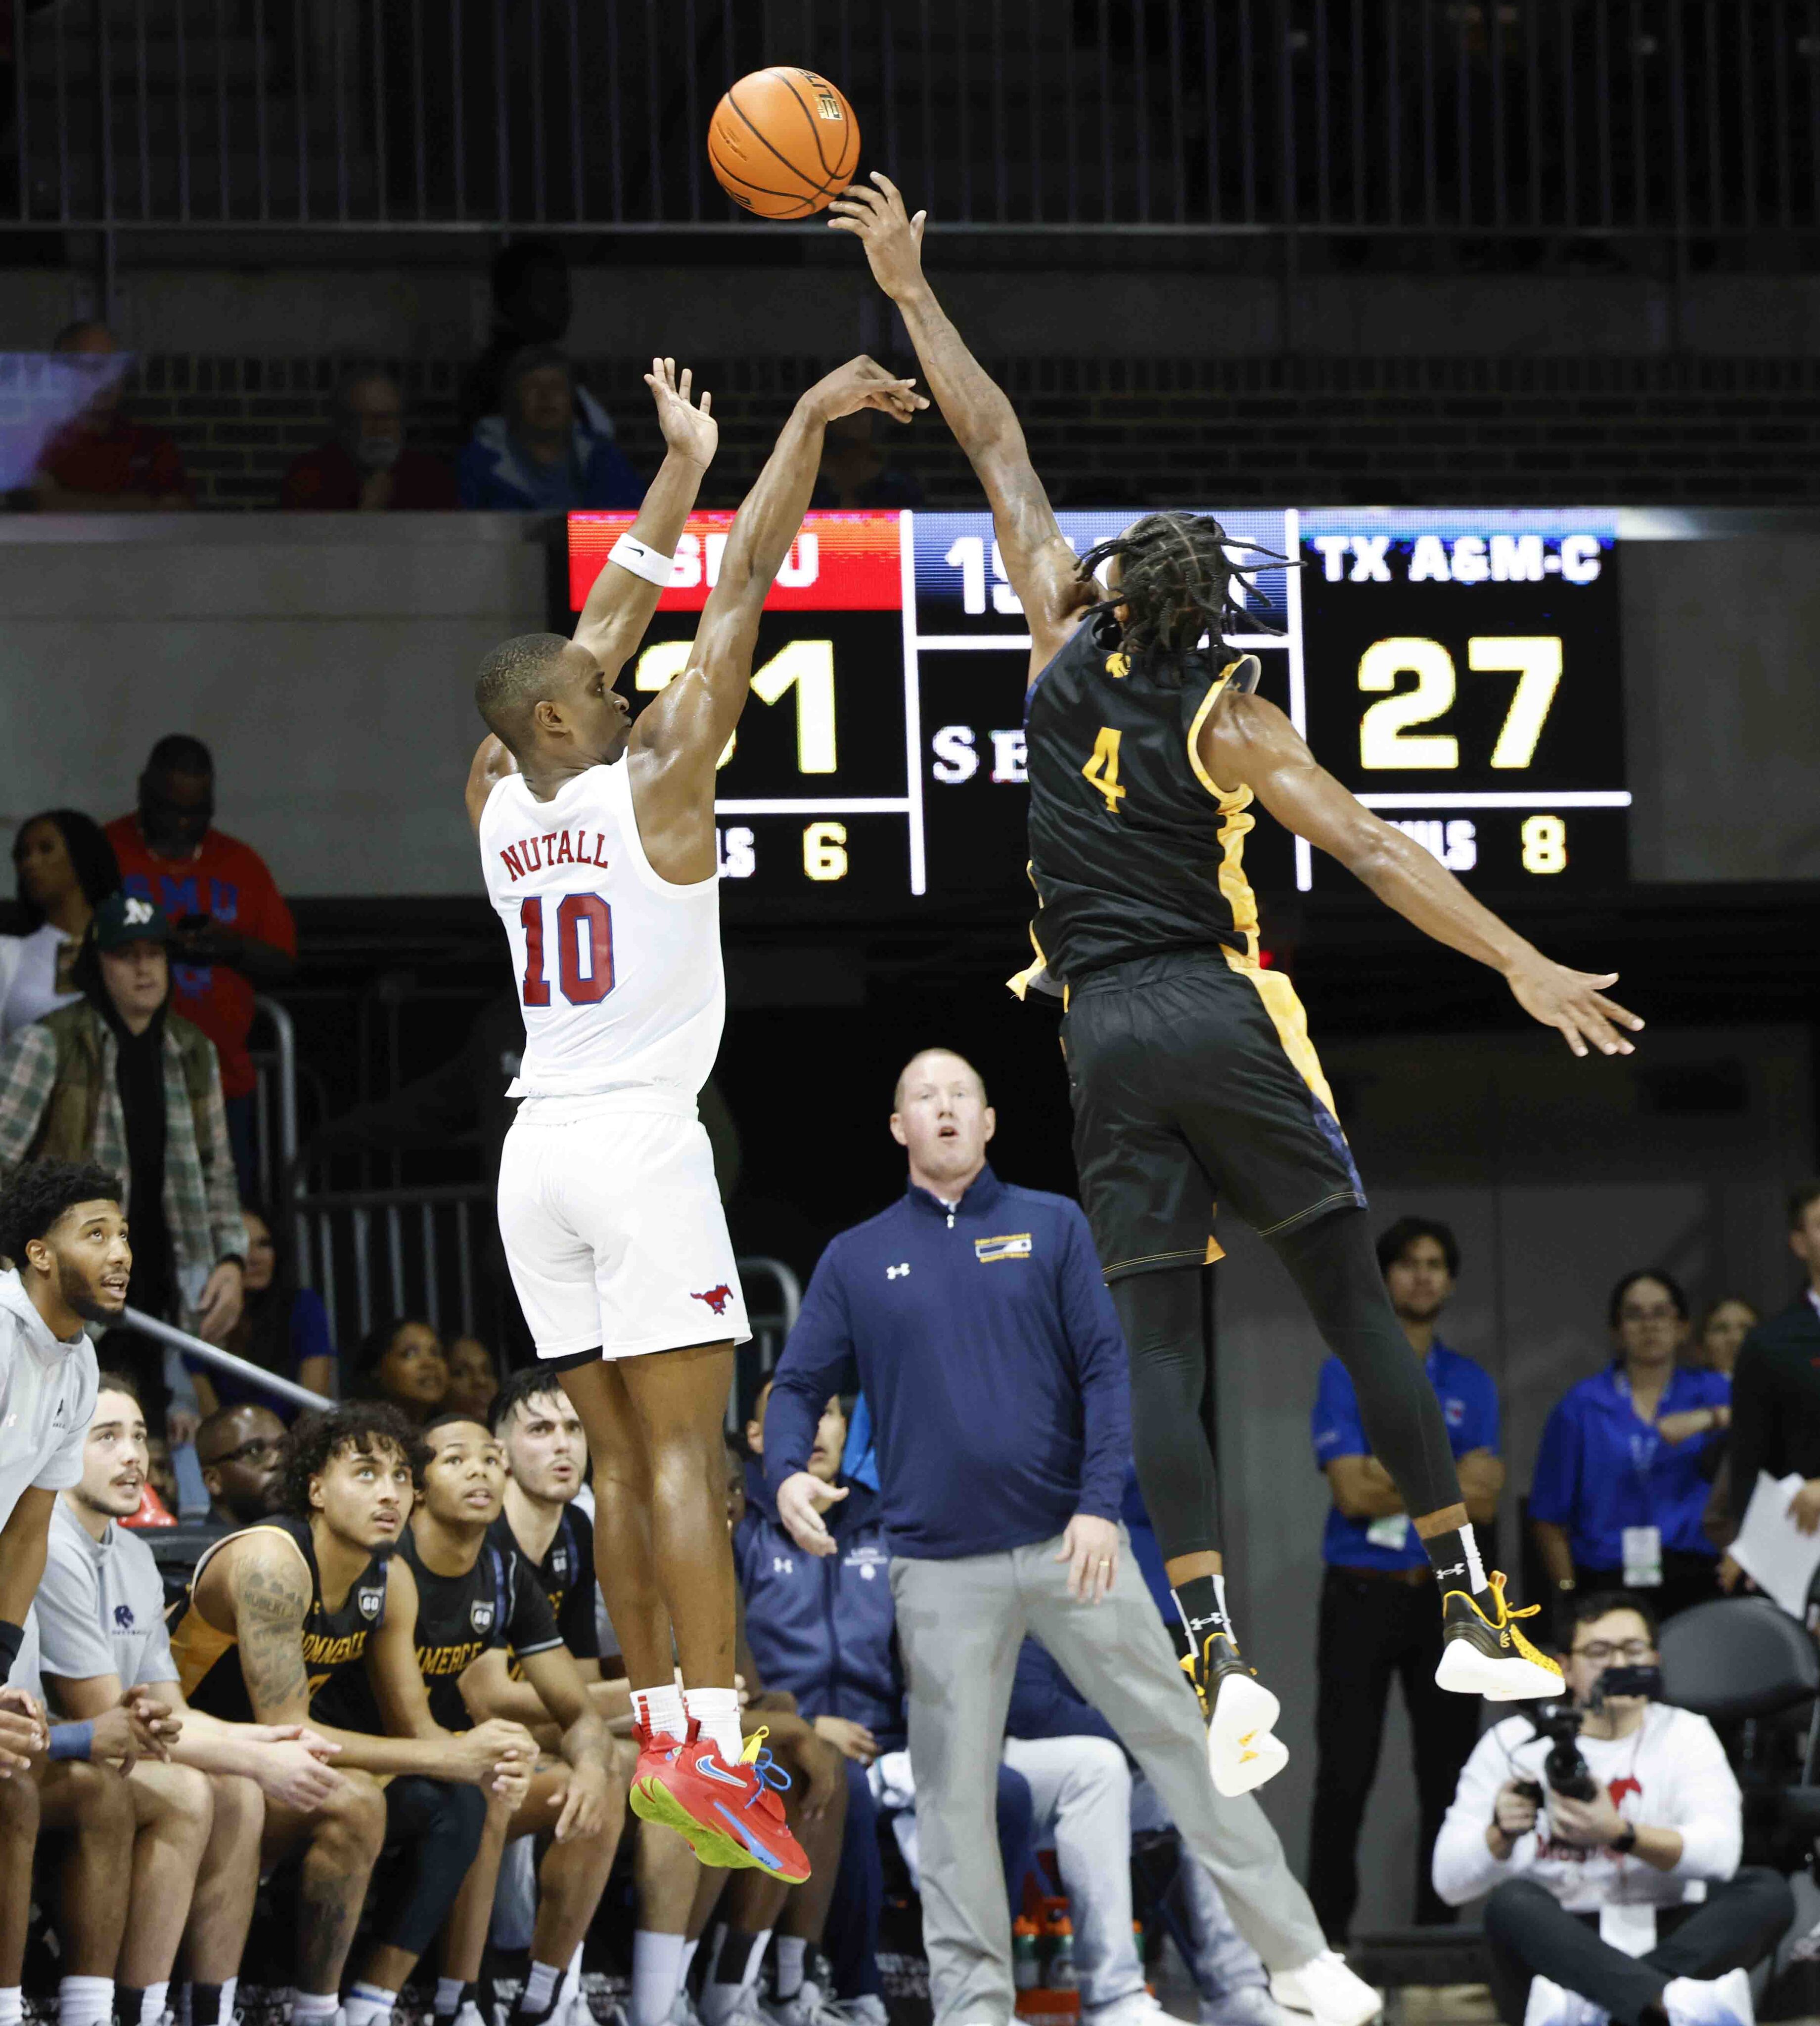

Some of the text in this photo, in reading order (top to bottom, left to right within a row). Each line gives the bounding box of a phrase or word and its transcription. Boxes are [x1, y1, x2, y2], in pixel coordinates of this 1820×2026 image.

[1315, 535, 1601, 583] TX A&M-C
[1358, 637, 1564, 769] 27
[1081, 726, 1127, 814] 4
[500, 830, 608, 882] NUTALL
[803, 822, 848, 880] 6
[1521, 815, 1567, 874] 8
[521, 892, 615, 1007] 10
